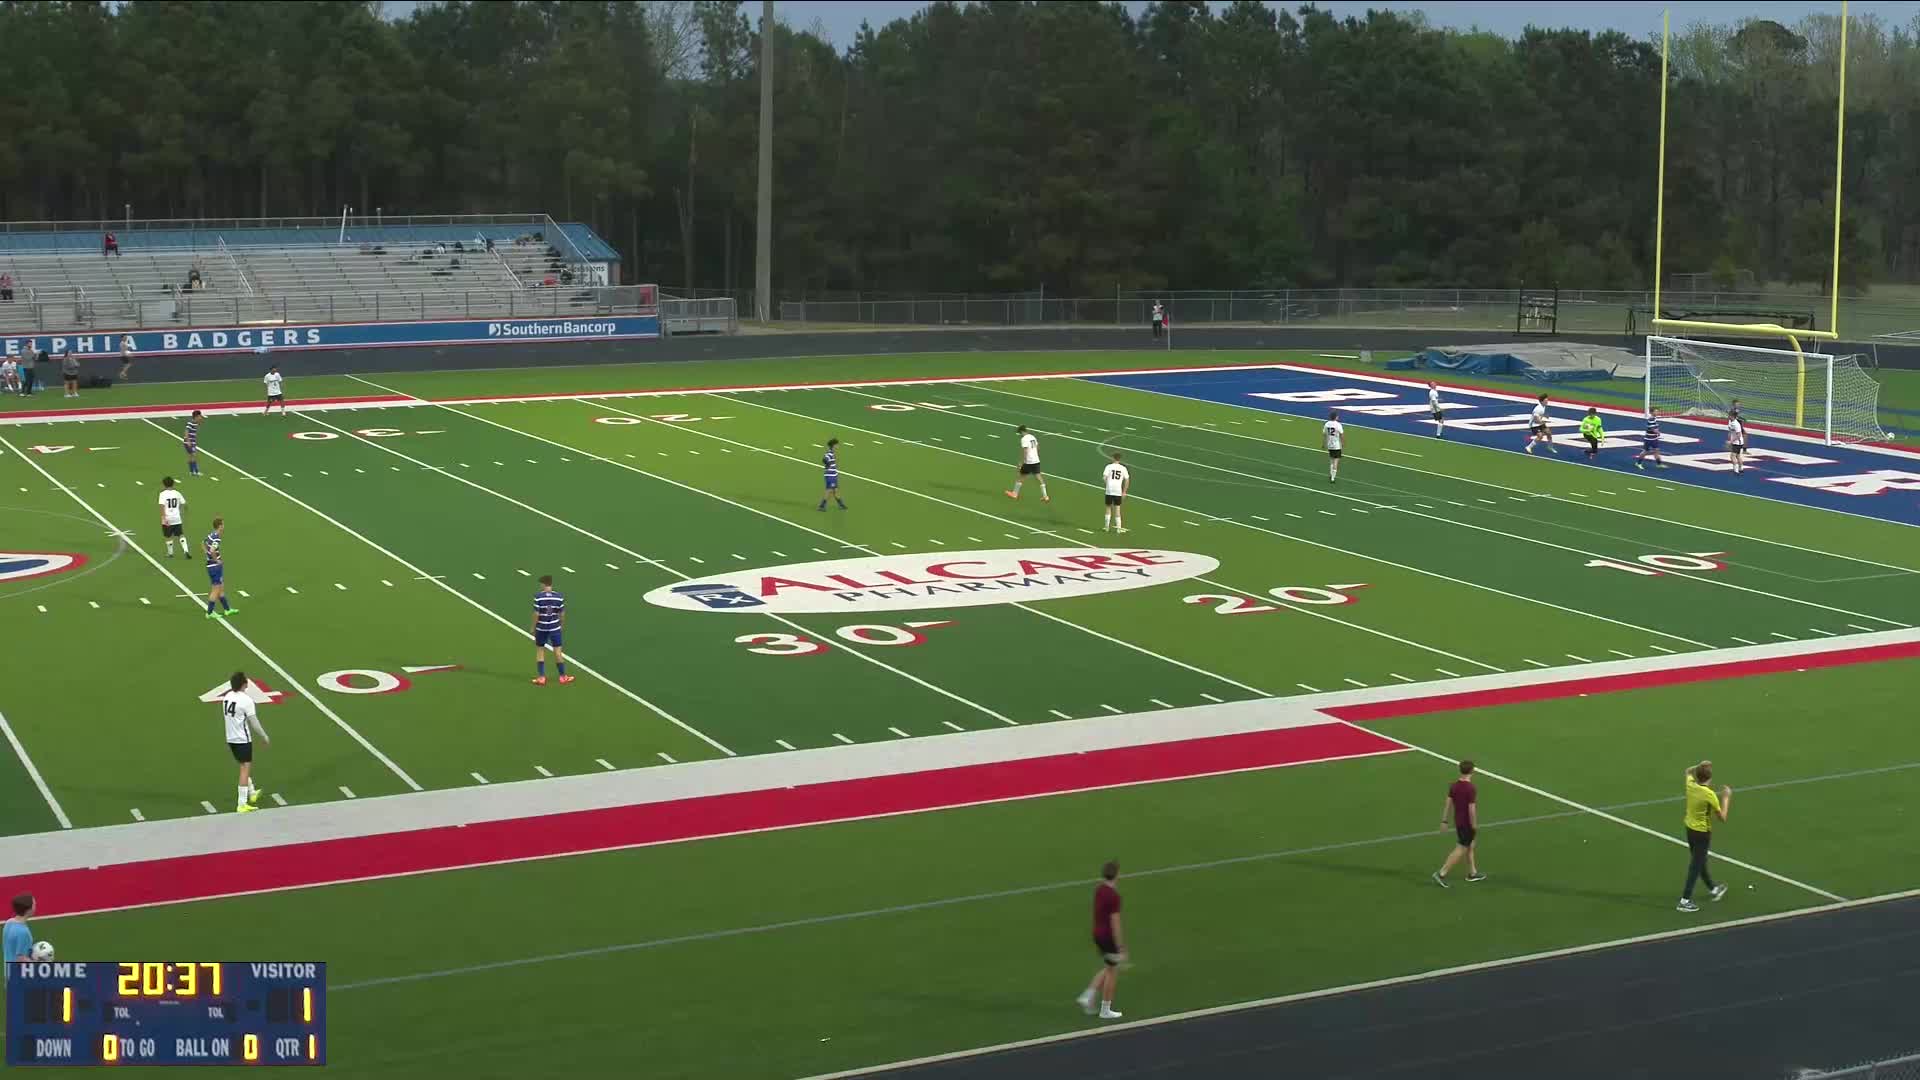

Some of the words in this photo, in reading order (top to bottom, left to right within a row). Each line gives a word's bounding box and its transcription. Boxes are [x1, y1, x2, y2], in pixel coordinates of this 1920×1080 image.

[163, 328, 321, 349] BADGERS
[1327, 427, 1336, 436] 12
[1111, 469, 1122, 480] 15
[166, 497, 178, 509] 10
[760, 550, 1184, 597] ALLCARE
[1584, 554, 1722, 576] 10
[832, 567, 1154, 602] PHARMACY
[1183, 584, 1352, 615] 20
[734, 622, 923, 656] 30
[224, 700, 237, 717] 14
